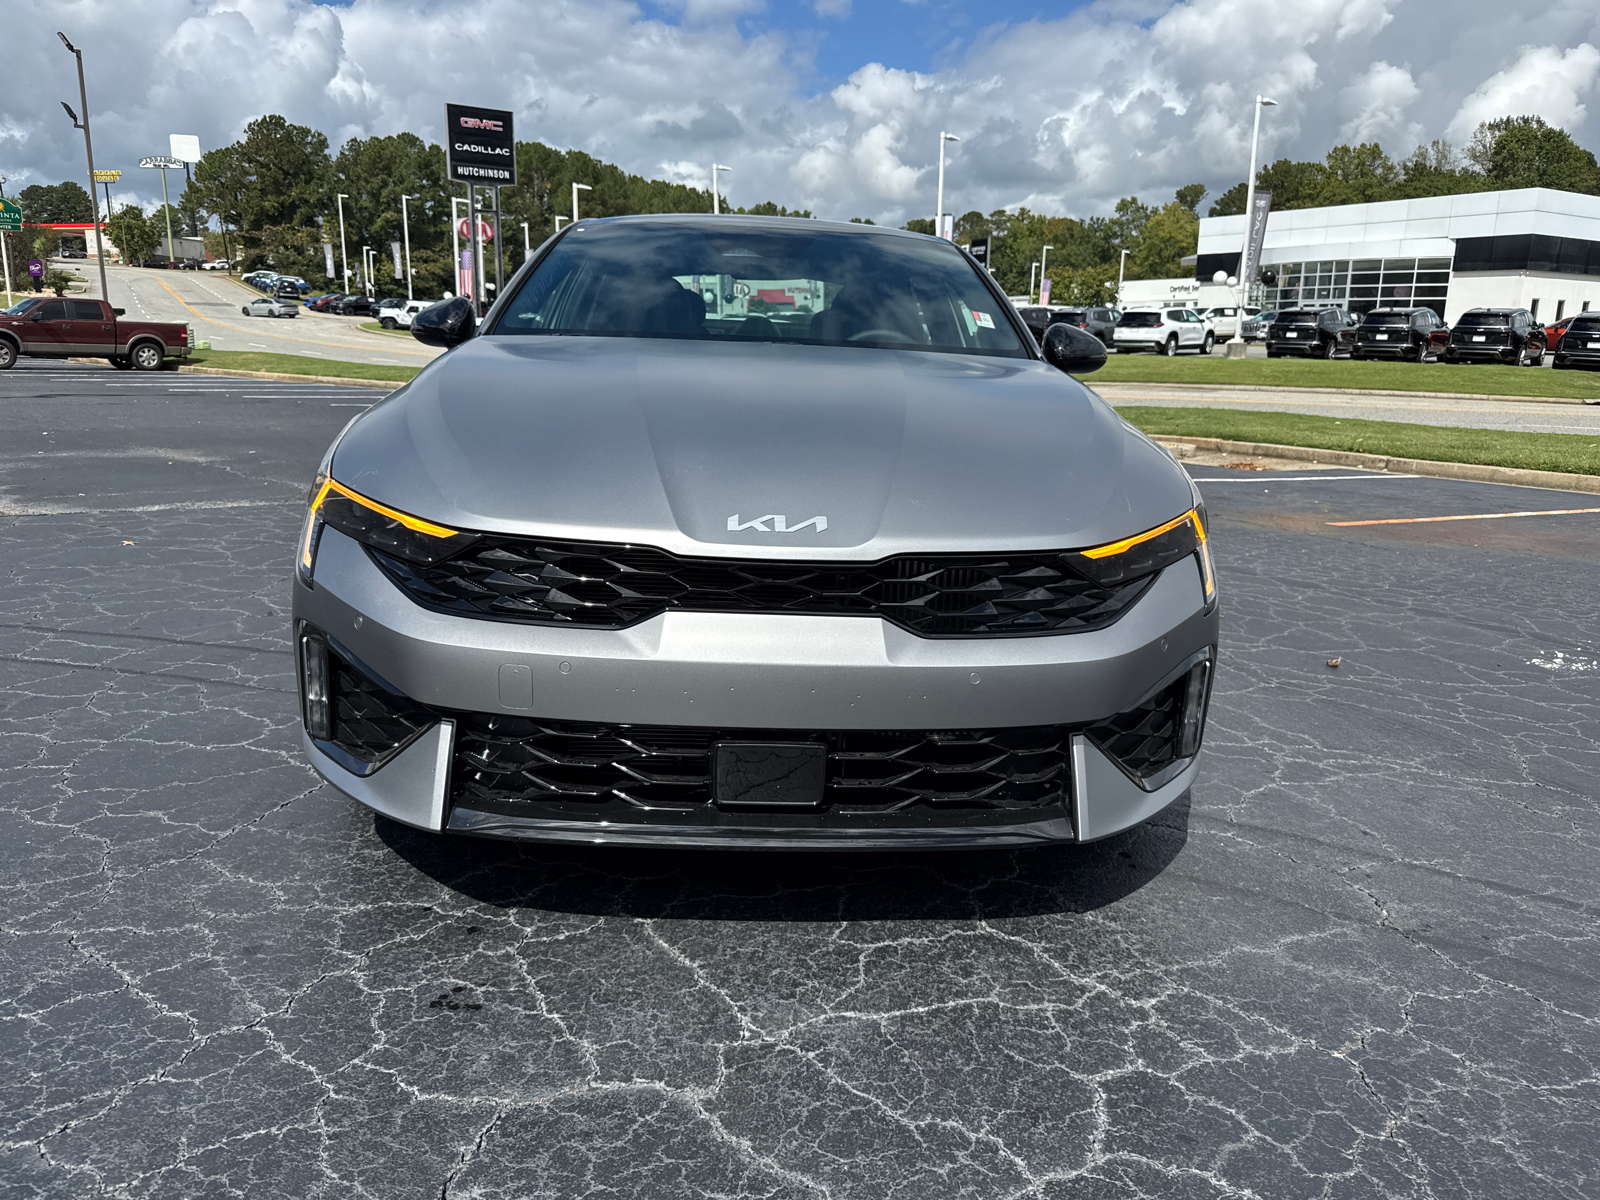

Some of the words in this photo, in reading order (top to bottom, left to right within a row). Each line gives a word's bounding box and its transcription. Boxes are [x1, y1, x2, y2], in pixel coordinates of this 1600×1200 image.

[460, 117, 503, 131] GMC
[455, 143, 510, 156] CADILLAC
[457, 166, 510, 179] HUTCHINSON
[727, 513, 828, 533] KIA
